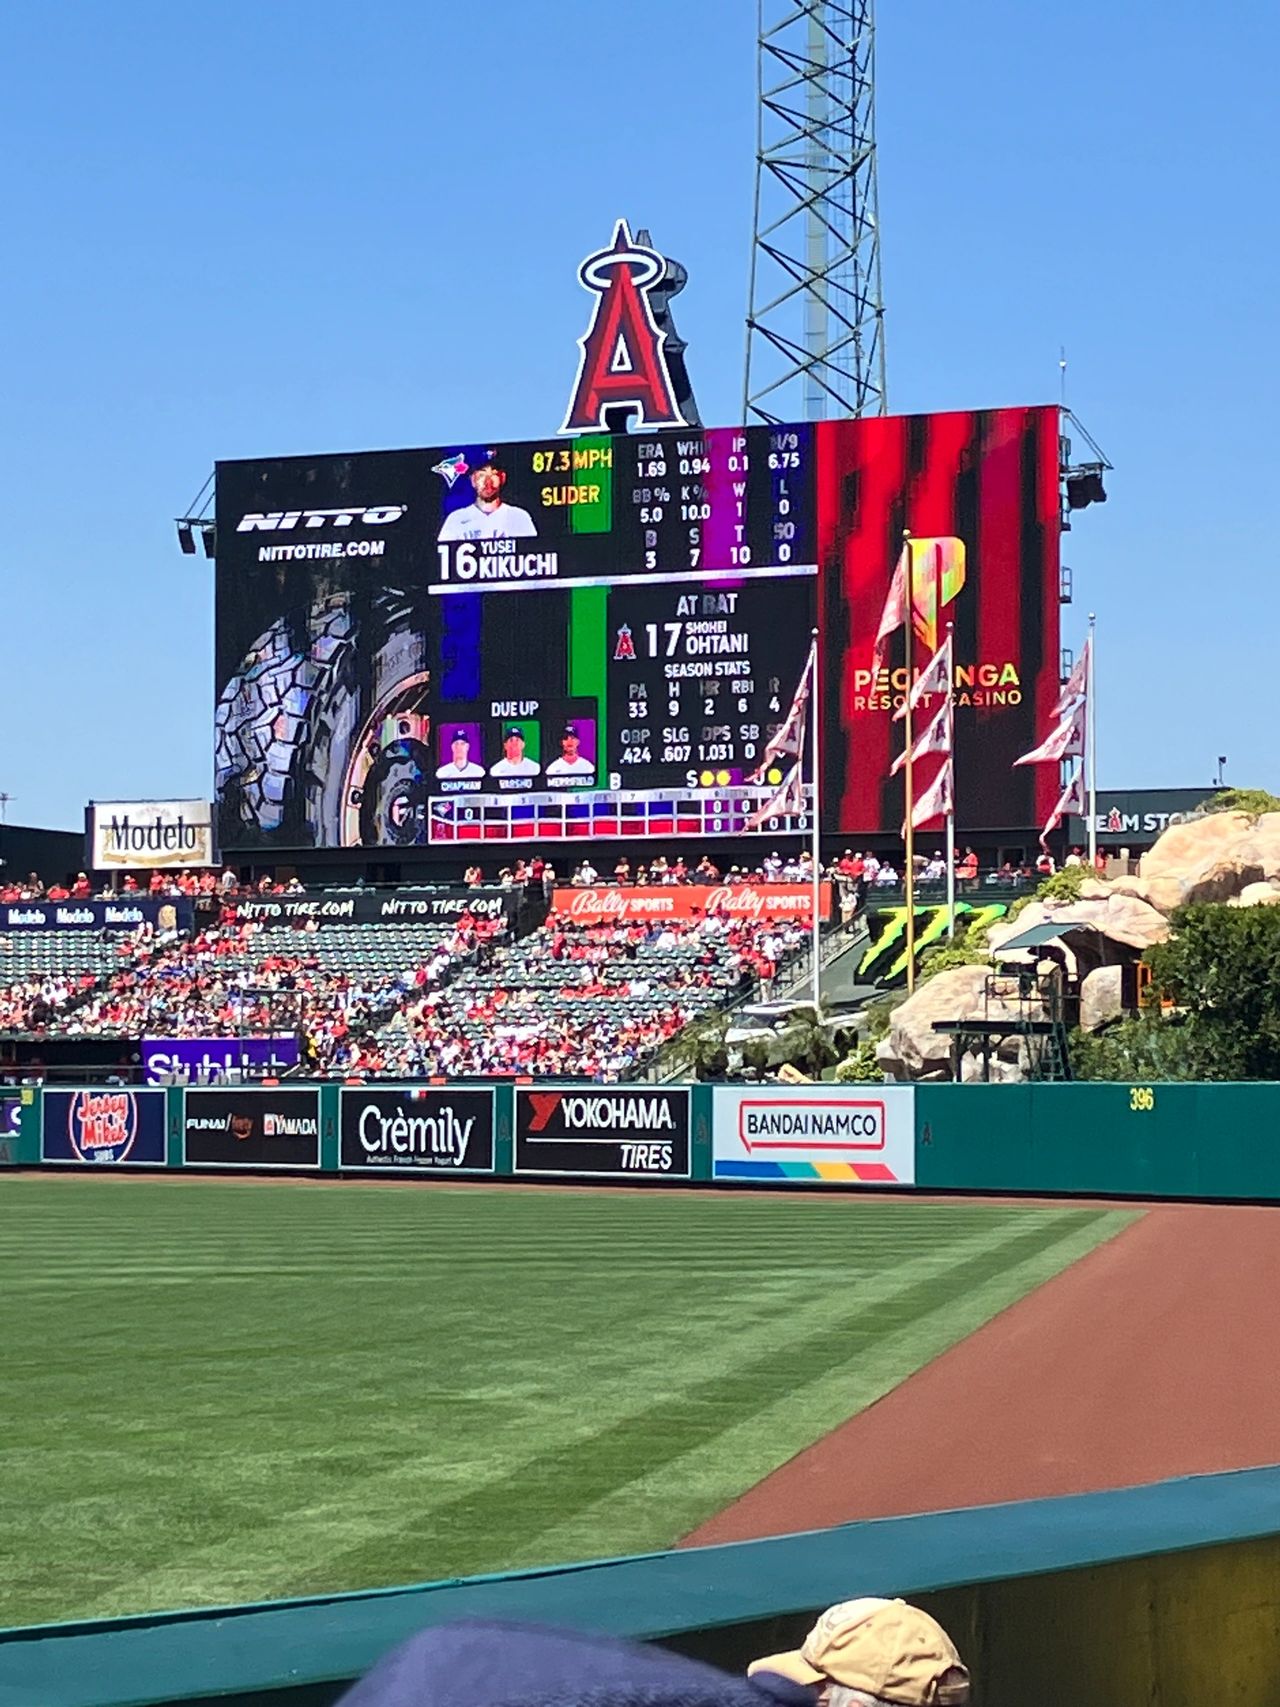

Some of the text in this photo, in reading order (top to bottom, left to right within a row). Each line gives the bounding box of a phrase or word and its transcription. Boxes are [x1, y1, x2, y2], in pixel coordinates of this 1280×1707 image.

[638, 443, 664, 459] ERA
[732, 437, 746, 453] IP
[532, 448, 613, 473] 87.3 MPH
[679, 458, 711, 475] 0.94
[728, 455, 749, 472] 0.1
[768, 453, 800, 470] 6.75
[637, 461, 667, 478] 1.69
[733, 482, 746, 497] W
[780, 479, 788, 494] L
[541, 485, 600, 507] SLIDER
[640, 507, 663, 523] 5.0
[681, 504, 711, 521] 10.0
[736, 501, 743, 517] 1
[779, 499, 790, 515] 0
[236, 505, 404, 532] NITTO
[689, 528, 699, 545] S
[734, 525, 744, 542] T
[258, 540, 385, 562] NITTOTIRE.COM
[481, 540, 516, 554] YUSEI
[730, 546, 750, 564] 10
[778, 543, 791, 561] 0
[437, 543, 558, 580] 16 KIKUCHI
[645, 551, 656, 569] 3
[689, 549, 700, 567] 7
[676, 593, 738, 616] AT BAT
[685, 620, 727, 635] SHOHEI
[645, 623, 748, 657] 17 OHTANI
[664, 660, 750, 679] SEASON STATS
[854, 662, 1020, 692] PECNGA
[629, 683, 648, 699] PA
[669, 682, 680, 698] H
[732, 680, 754, 694] RBI
[491, 700, 539, 717] DUE UP
[629, 702, 648, 718] 33
[668, 700, 679, 717] 9
[704, 699, 714, 715] 2
[738, 698, 748, 713] 6
[769, 697, 780, 712] 4
[621, 729, 650, 744] OBP
[663, 727, 689, 743] SLG
[702, 725, 731, 741] OPS
[740, 724, 759, 740] SB
[620, 747, 651, 764] .424
[660, 746, 691, 763] .607
[699, 744, 734, 761] 1.031
[745, 743, 755, 759] 0
[609, 772, 621, 790] B
[686, 769, 698, 788] S
[111, 815, 196, 850] Modelo
[236, 900, 354, 918] NITTO TIRE.COM
[381, 897, 503, 915] NITTO TIRECOM
[571, 889, 673, 918] Bally SPORTS
[766, 895, 810, 910] SPORTS
[8, 908, 46, 924] Modelo
[56, 907, 95, 923] Modelo
[105, 906, 143, 923] Modelo
[77, 1091, 128, 1121] Jersey
[1129, 1087, 1154, 1110] 396
[562, 1098, 673, 1129] YOKOHAMA
[276, 1114, 317, 1135] YAMADA
[747, 1114, 876, 1136] BANDAI NAMCO
[359, 1105, 474, 1166] Crèmily
[620, 1145, 673, 1170] TIRES
